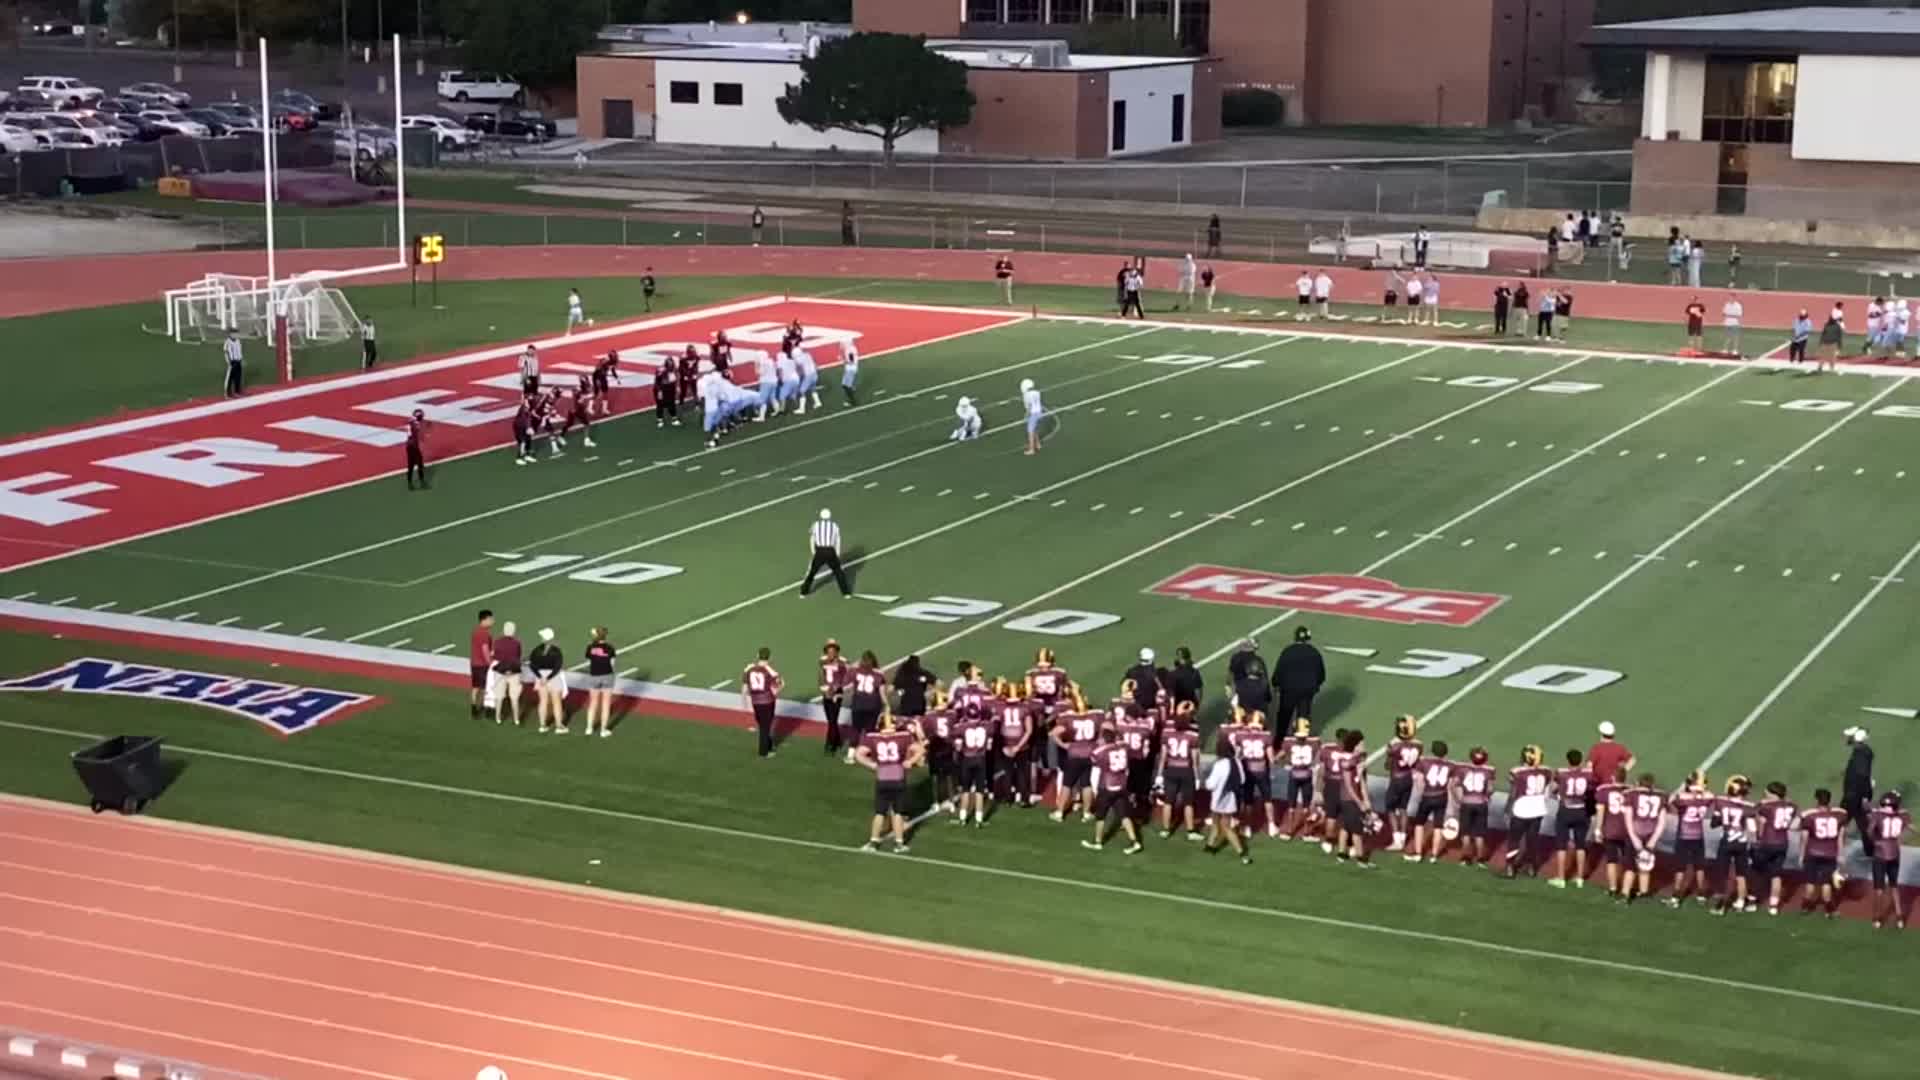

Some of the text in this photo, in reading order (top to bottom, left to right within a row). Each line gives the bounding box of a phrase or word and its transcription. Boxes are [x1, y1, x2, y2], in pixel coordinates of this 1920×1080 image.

[421, 236, 443, 263] 25
[0, 321, 863, 526] FRIENDS
[496, 555, 684, 584] 10
[1179, 574, 1489, 617] KCAC
[881, 596, 1123, 635] 20
[1366, 649, 1624, 694] 30
[0, 657, 375, 734] NAIA
[876, 741, 899, 762] 93
[1637, 795, 1660, 818] 57
